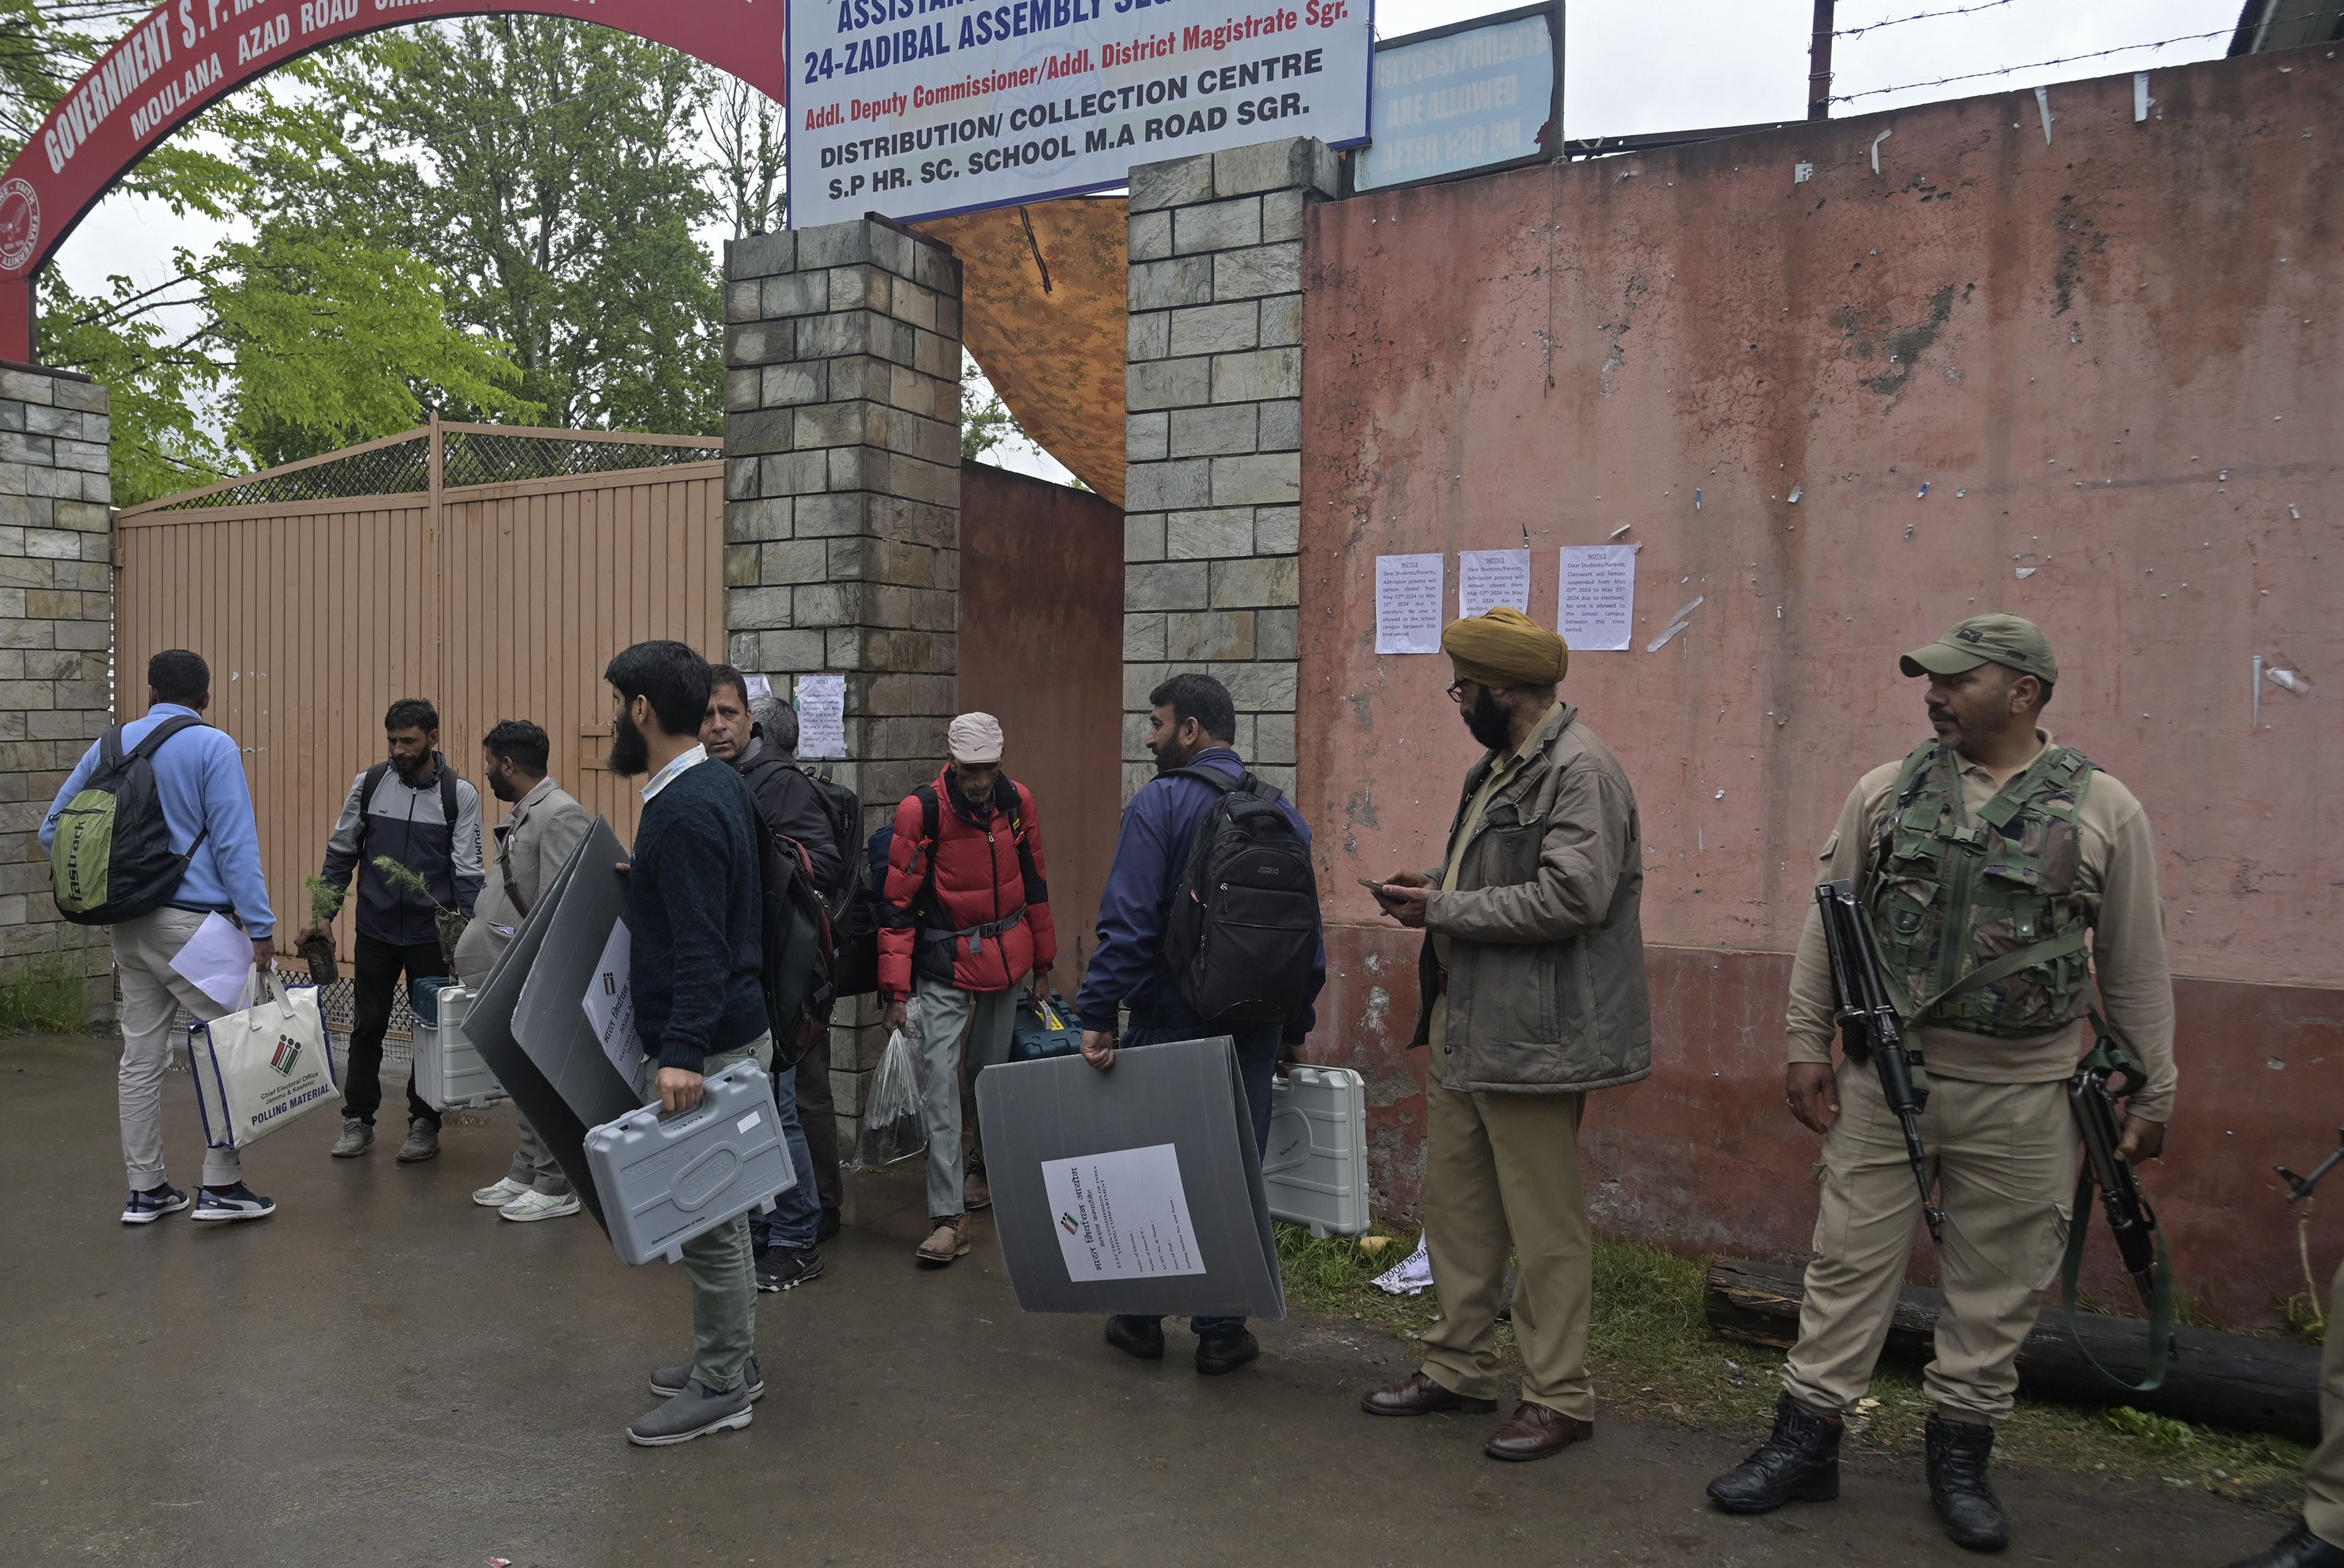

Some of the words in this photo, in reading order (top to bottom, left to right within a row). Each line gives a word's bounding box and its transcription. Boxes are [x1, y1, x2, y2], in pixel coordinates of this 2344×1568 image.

[838, 0, 981, 33] ASSIS
[805, 22, 950, 84] 24-ZADIBAL
[958, 0, 1100, 50] ASSEMBLY
[130, 52, 223, 141] MOULANA
[238, 13, 290, 66] AZAD
[300, 0, 359, 34] ROAD
[805, 103, 845, 131] Addl.
[850, 92, 908, 122] Deputy
[913, 49, 1094, 108] Commissioner/Addl.
[1102, 31, 1176, 69] District
[1183, 9, 1297, 51] Magistrate
[1305, 0, 1349, 29] Sgr.
[44, 11, 172, 174] GOVERNMENT
[821, 113, 1004, 169] DISTRIBUTION/
[1010, 75, 1187, 132] COLLECTION
[1198, 48, 1323, 94] CENTRE
[1427, 75, 1518, 120] ALLOWED
[828, 175, 865, 200] S.P
[872, 168, 912, 193] HR.
[920, 158, 960, 184] SC.
[968, 135, 1076, 175] SCHOOL
[1085, 123, 1135, 153] M.A
[1145, 106, 1228, 143] ROAD
[1236, 92, 1310, 125] SGR.
[67, 821, 86, 902] fastrack
[475, 830, 483, 863] PUMA
[252, 1102, 287, 1126] POLLING
[290, 1084, 329, 1109] MATERIAL
[261, 1089, 276, 1100] Chief
[277, 1079, 301, 1093] Electoral
[302, 1071, 318, 1082] Office
[265, 1093, 286, 1105] Jammu
[292, 1080, 315, 1093] Kashmir
[1071, 1166, 1083, 1200] आयोग
[1096, 1184, 1102, 1194] OF
[1079, 1203, 1094, 1243] निर्वाचन
[1099, 1194, 1113, 1236] COMMISSION
[1100, 1179, 1115, 1228] COMPARTMENT
[1090, 1246, 1102, 1271] भारत
[1110, 1237, 1121, 1268] ELECTION
[1112, 1230, 1121, 1254] VOTING
[1407, 1247, 1428, 1265] TROL
[1379, 1264, 1406, 1282] ROOM
